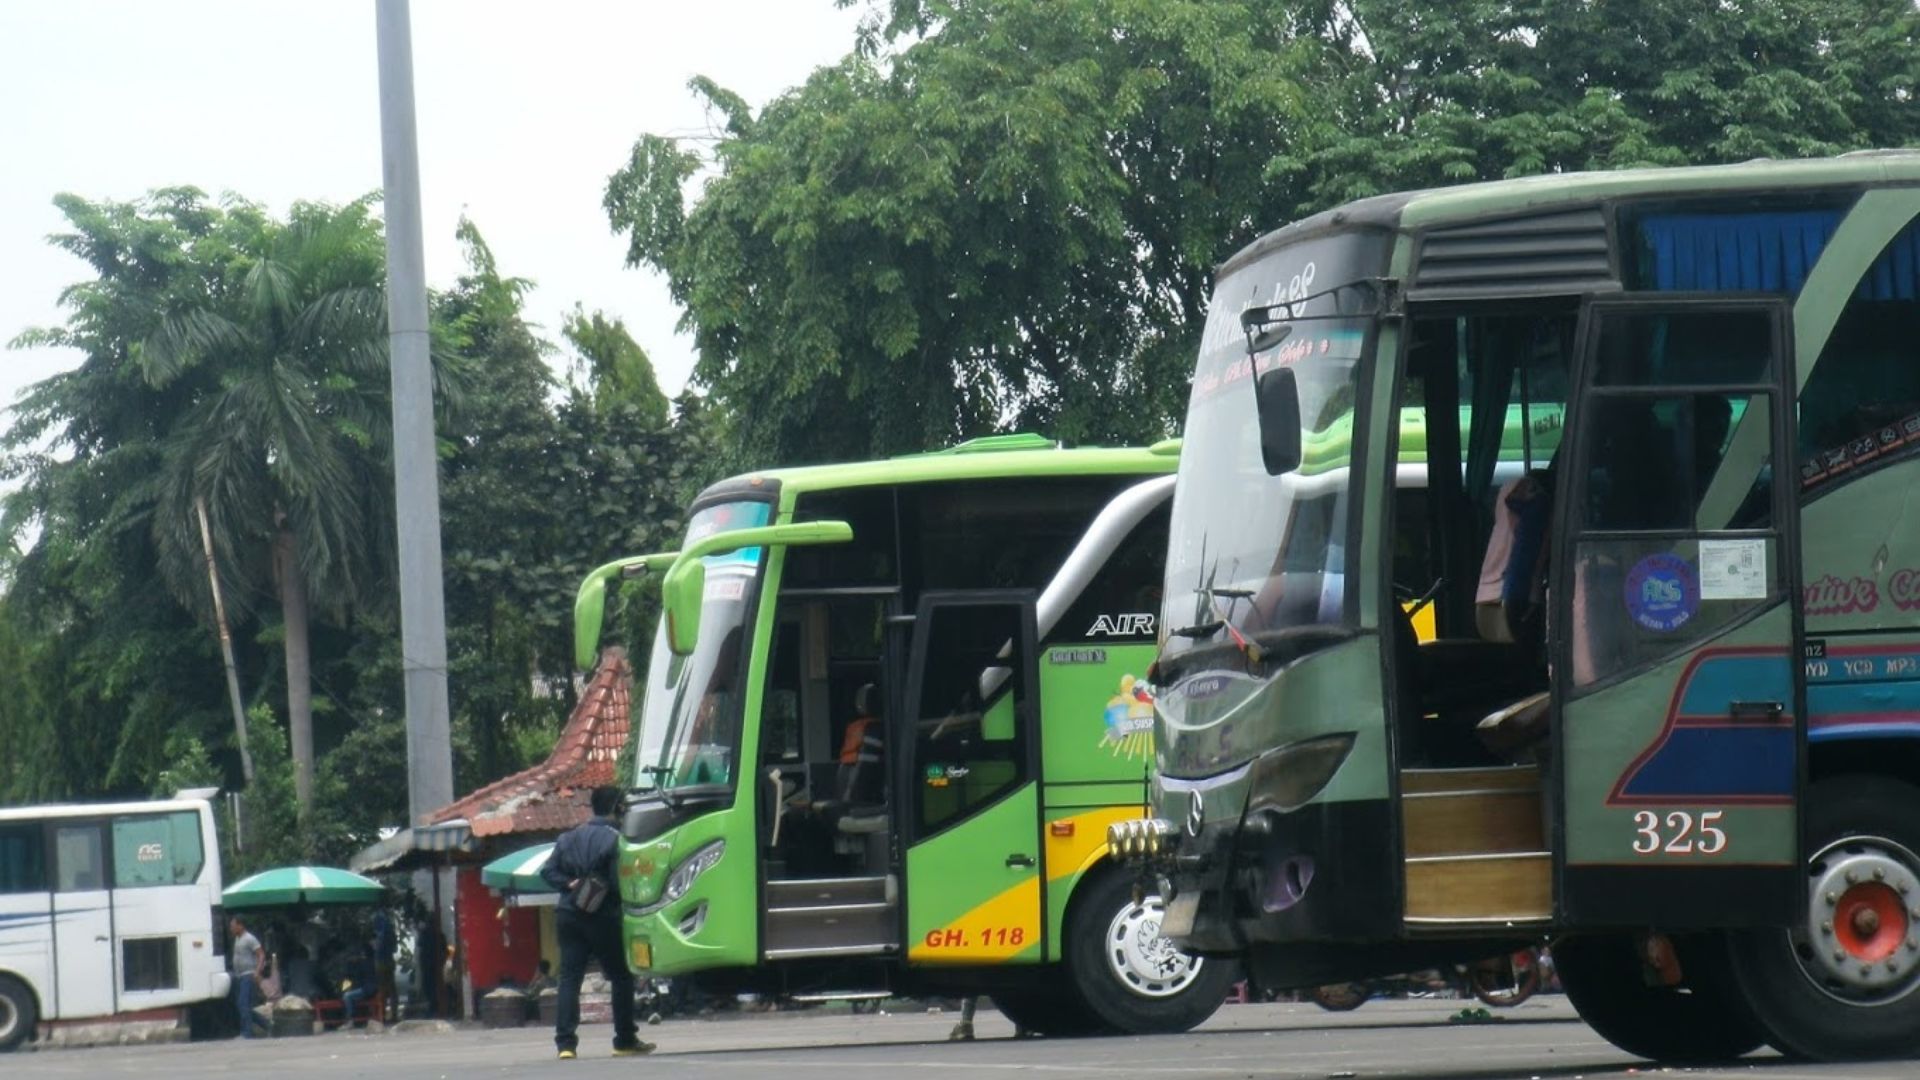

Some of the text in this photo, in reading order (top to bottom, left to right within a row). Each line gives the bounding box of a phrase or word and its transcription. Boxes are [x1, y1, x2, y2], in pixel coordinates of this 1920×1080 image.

[1085, 612, 1154, 636] AIR
[1886, 658, 1917, 673] MP3
[1632, 810, 1727, 854] 325
[138, 843, 162, 854] AC
[925, 927, 1024, 948] GH. 118
